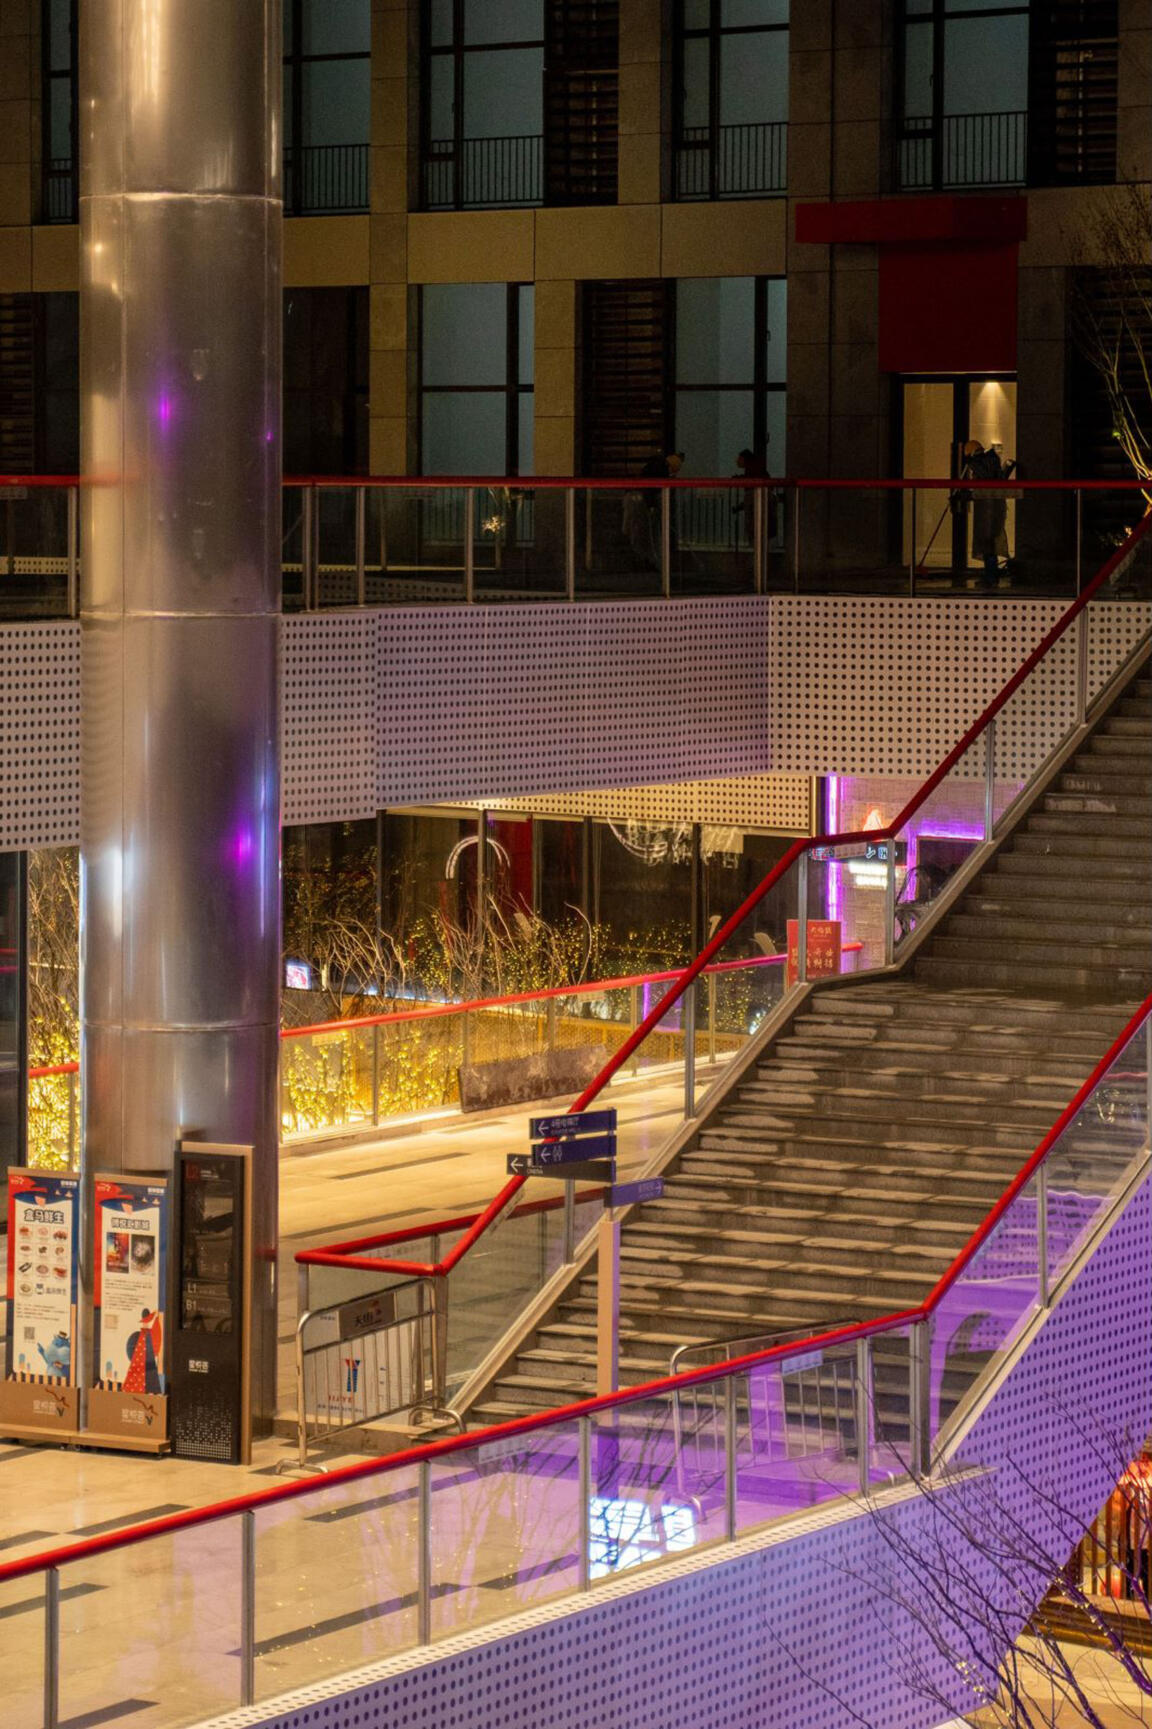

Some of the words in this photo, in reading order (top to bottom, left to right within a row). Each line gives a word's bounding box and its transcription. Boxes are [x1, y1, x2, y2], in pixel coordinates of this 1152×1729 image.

[24, 1208, 64, 1224] 盒马鲜生
[187, 1282, 197, 1294] L1
[186, 1299, 197, 1311] B1
